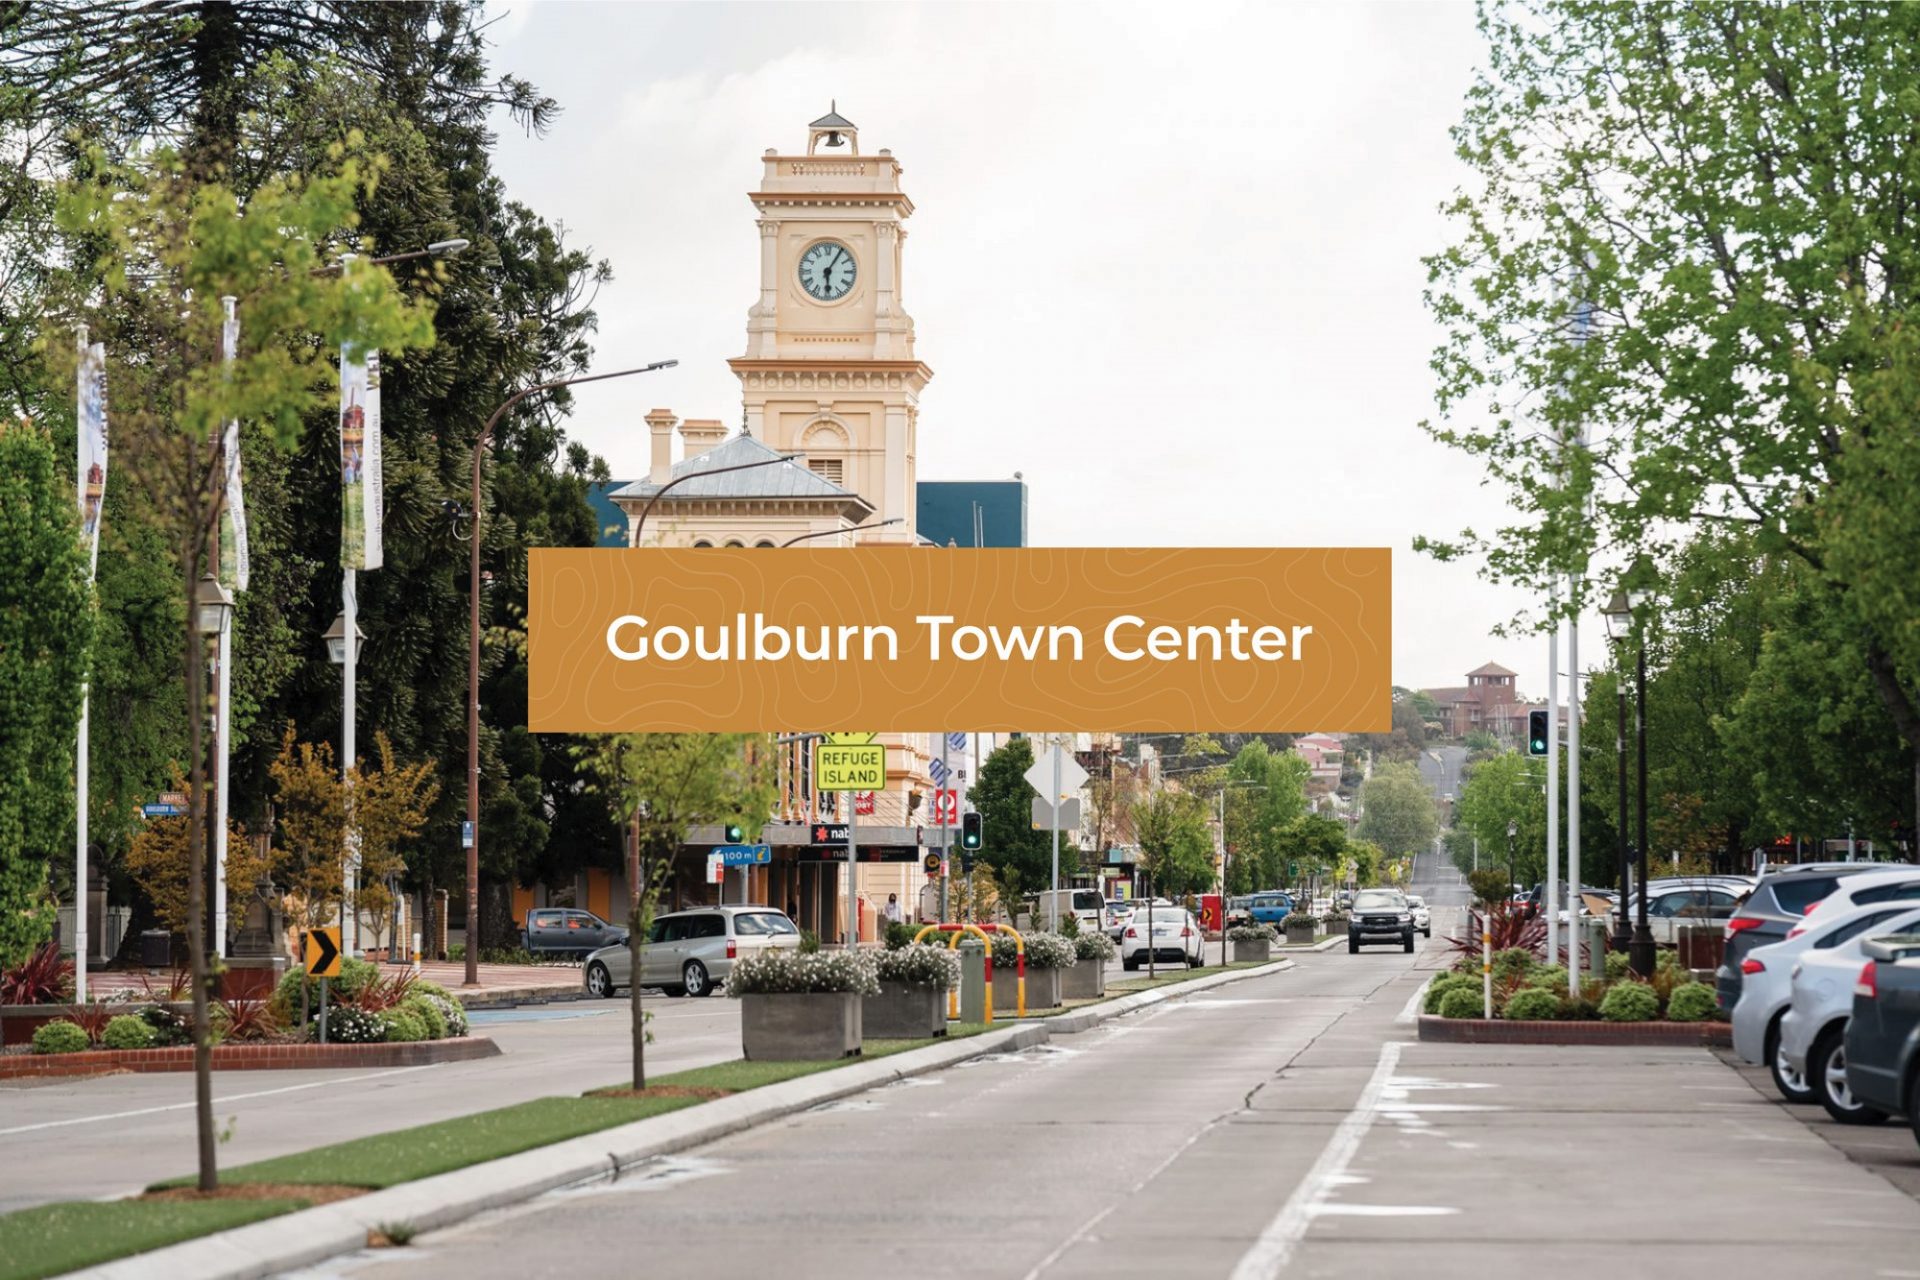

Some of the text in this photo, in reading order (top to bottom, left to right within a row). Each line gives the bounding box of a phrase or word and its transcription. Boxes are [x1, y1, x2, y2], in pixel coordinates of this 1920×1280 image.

[823, 752, 879, 765] REFUGE
[824, 770, 878, 783] ISLAND
[725, 852, 742, 860] 100
